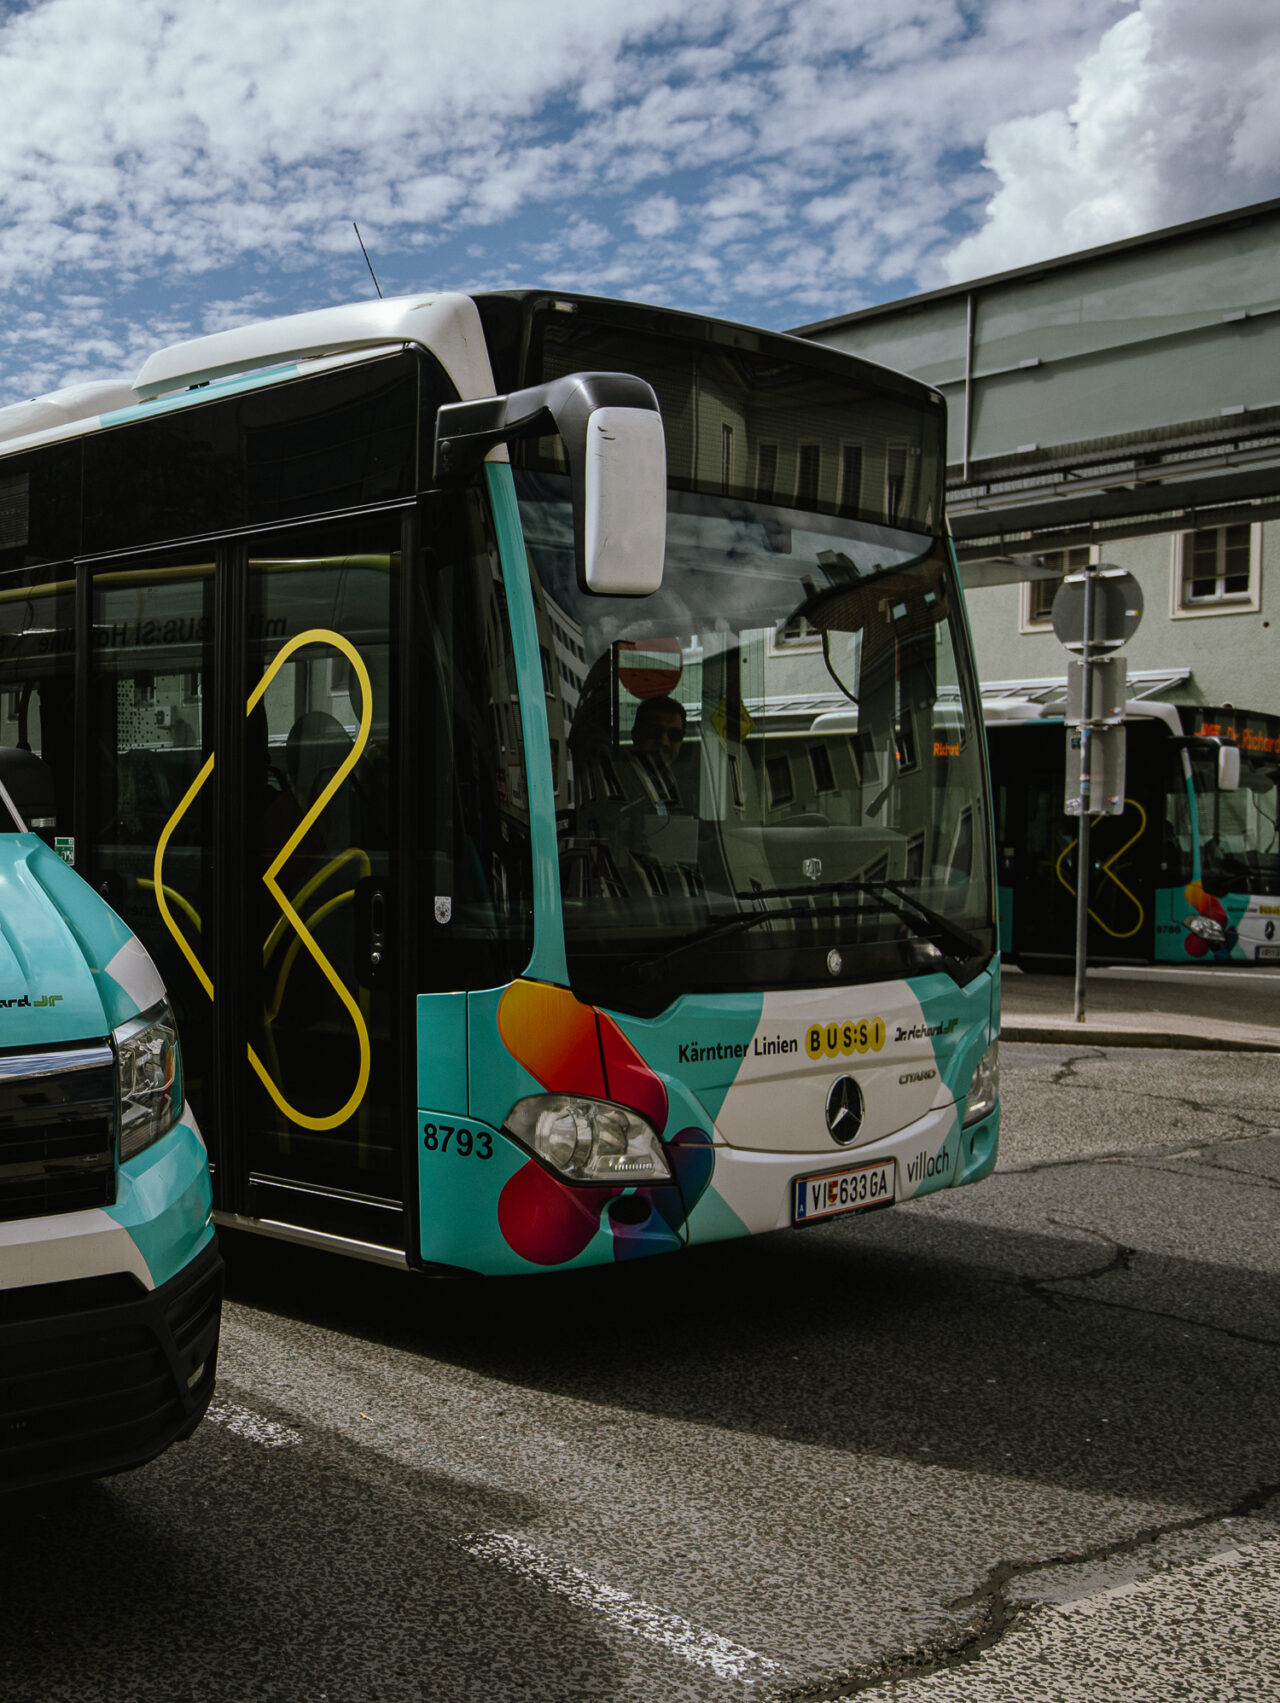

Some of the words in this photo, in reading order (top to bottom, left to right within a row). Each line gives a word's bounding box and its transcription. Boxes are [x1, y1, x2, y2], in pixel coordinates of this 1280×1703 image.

[678, 1041, 749, 1063] Kärntner
[754, 1035, 798, 1057] Linien
[810, 1023, 880, 1052] BUS:SI
[423, 1123, 493, 1160] 8793
[906, 1148, 949, 1183] villach
[812, 1182, 827, 1211] VI
[840, 1174, 867, 1204] 633
[870, 1169, 888, 1197] GA
